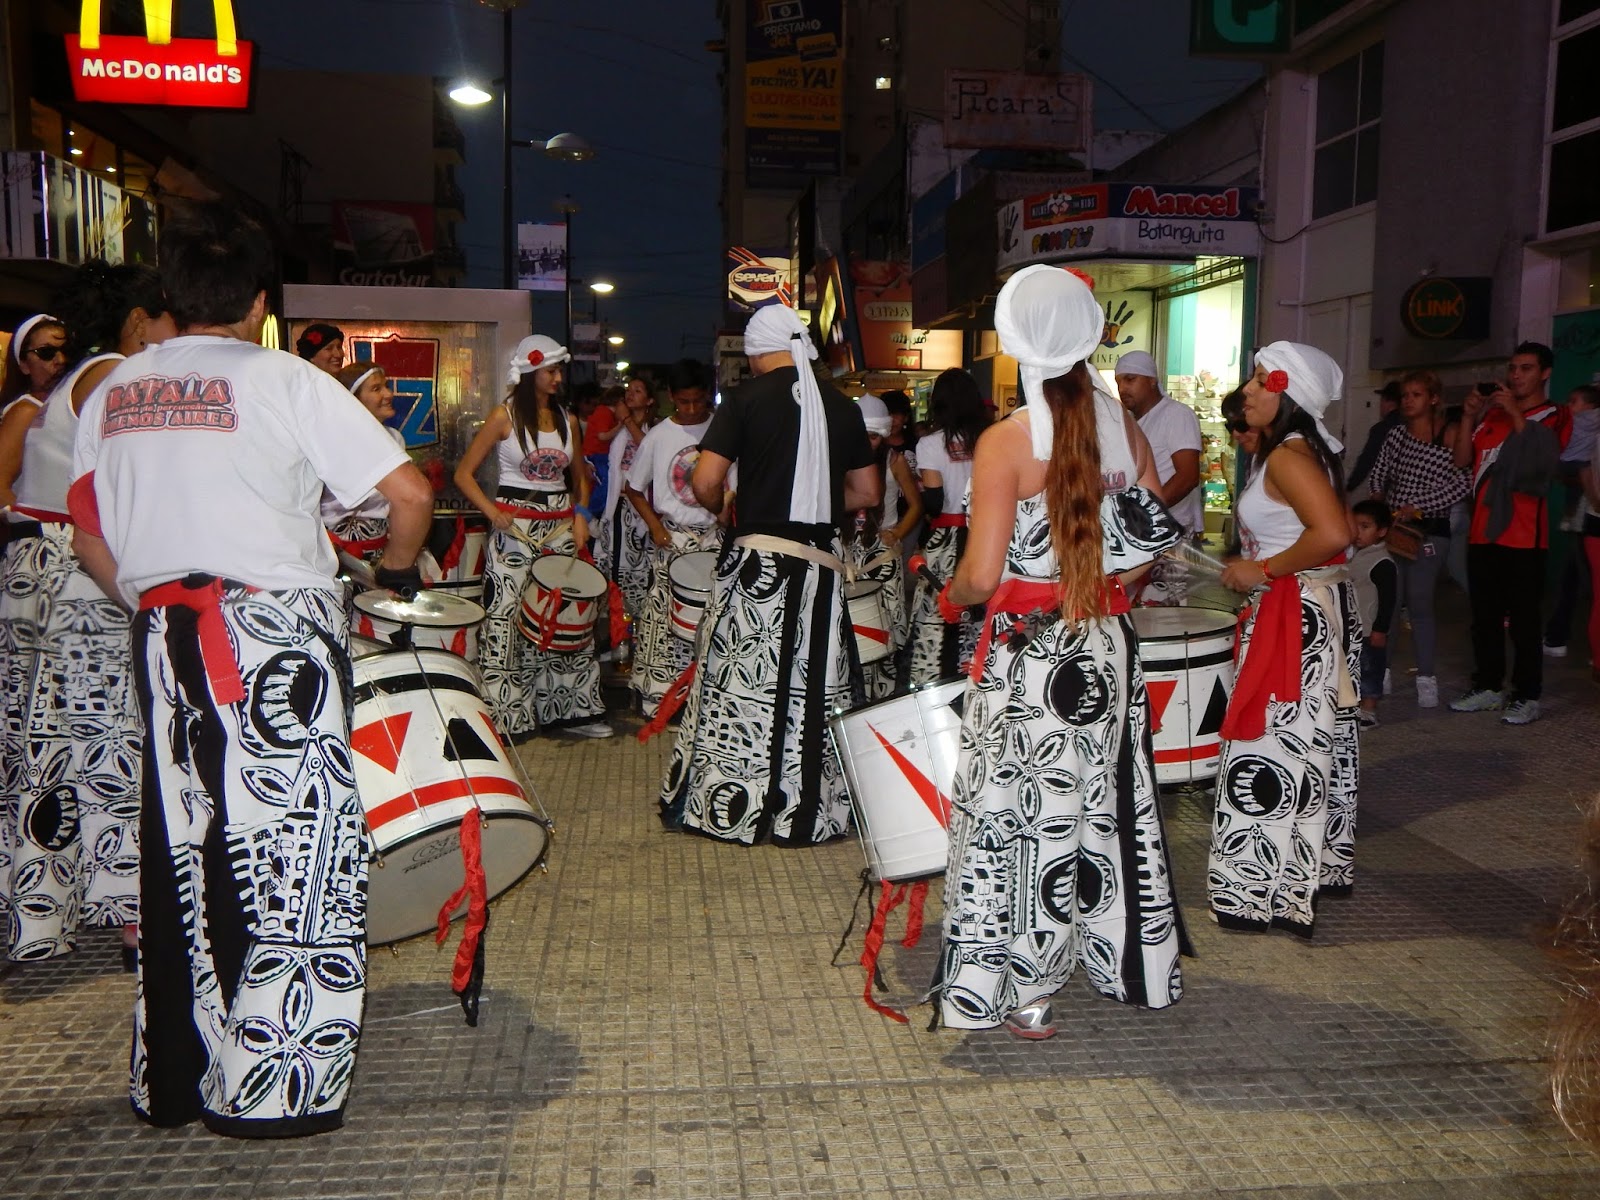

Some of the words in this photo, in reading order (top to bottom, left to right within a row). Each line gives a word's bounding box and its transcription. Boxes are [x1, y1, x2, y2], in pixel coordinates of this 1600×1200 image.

[82, 58, 242, 84] McDonald's
[801, 65, 837, 88] YA!
[1123, 185, 1240, 218] Marcel
[1138, 219, 1225, 244] Botanguita
[749, 282, 778, 290] SPORT
[896, 355, 919, 366] TNT
[168, 410, 235, 428] AIRES
